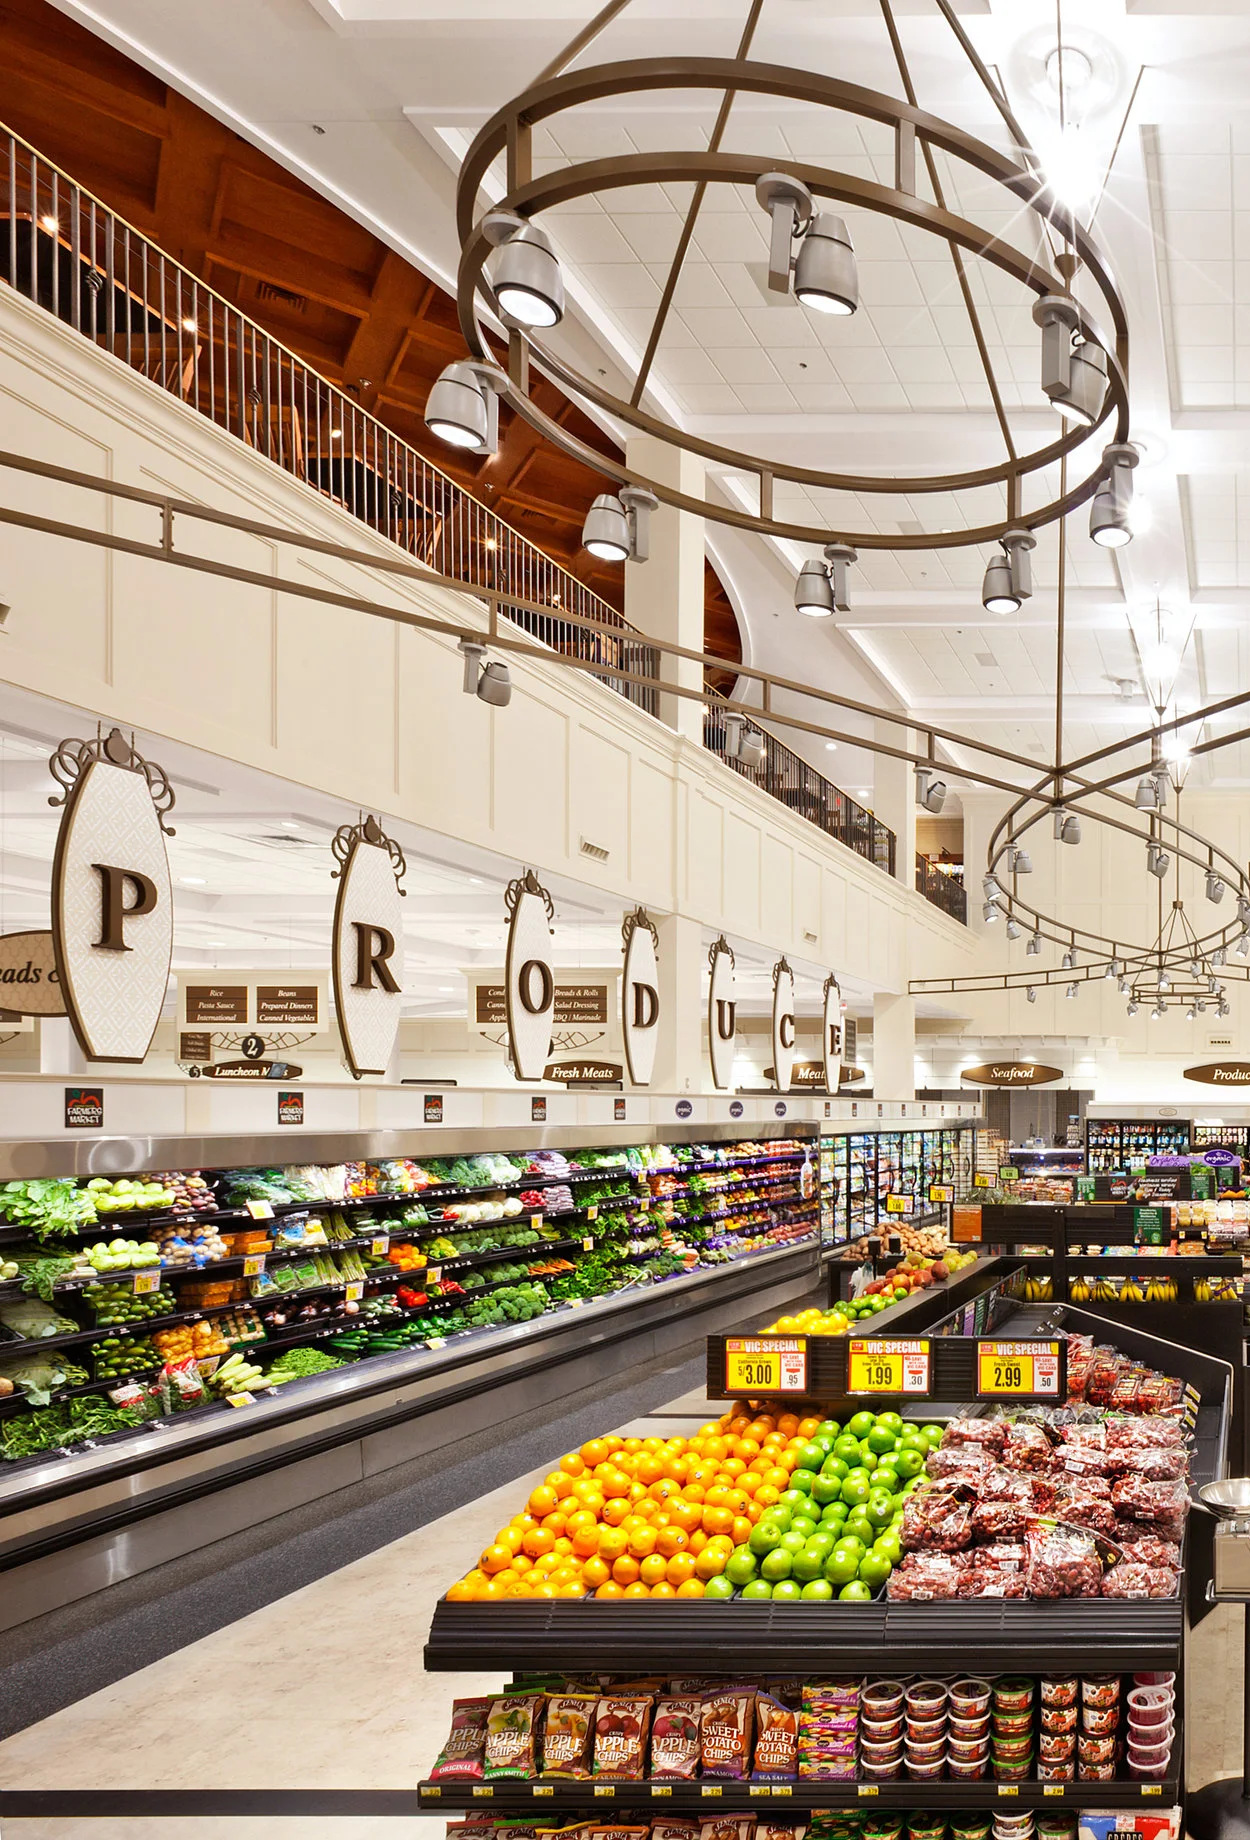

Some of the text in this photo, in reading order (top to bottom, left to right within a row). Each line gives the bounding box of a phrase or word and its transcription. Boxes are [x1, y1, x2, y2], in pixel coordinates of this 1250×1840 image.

[91, 863, 158, 951] P
[351, 922, 402, 993] R
[519, 959, 554, 1014] O
[632, 982, 660, 1027] D
[716, 999, 737, 1040] U
[780, 1014, 795, 1049] C
[830, 1024, 842, 1055] E
[0, 961, 42, 983] ads
[209, 989, 224, 997] Rice
[278, 989, 297, 997] Beans
[198, 1001, 235, 1009] Pasta Sauce
[261, 1002, 288, 1010] Prepared
[555, 1001, 599, 1010] Salad Dressing
[285, 1014, 316, 1022] Vegetables
[489, 1014, 507, 1022] Apple
[246, 1038, 258, 1056] 2
[214, 1067, 260, 1076] Luncheon
[551, 1067, 613, 1078] Fresh Meats
[991, 1067, 1035, 1081] Seafood
[1205, 1155, 1231, 1164] organic
[744, 1340, 799, 1353] VIC SPECIAL
[867, 1341, 922, 1354] VIC SPECIAL
[996, 1343, 1052, 1355] VIC SPECIAL
[866, 1366, 892, 1385] 1.99
[909, 1375, 923, 1385] .30
[994, 1367, 1021, 1387] 2.99
[1040, 1377, 1051, 1387] .50
[714, 1697, 737, 1708] SENECA
[702, 1725, 740, 1739] SWEET
[761, 1731, 796, 1743] SWEET
[445, 1741, 480, 1752] CHIPS
[595, 1736, 638, 1754] APPLE
[652, 1737, 697, 1754] APPLE
[702, 1737, 741, 1751] POTATO
[757, 1742, 796, 1755] POTATO
[488, 1745, 521, 1758] CHIPS
[545, 1749, 574, 1761] CHIPS
[597, 1751, 629, 1762] CHIPS
[653, 1751, 686, 1763] CHIPS
[704, 1748, 733, 1759] CHIPS
[759, 1752, 790, 1764] CHIPS
[439, 1764, 472, 1774] ORIGINAL
